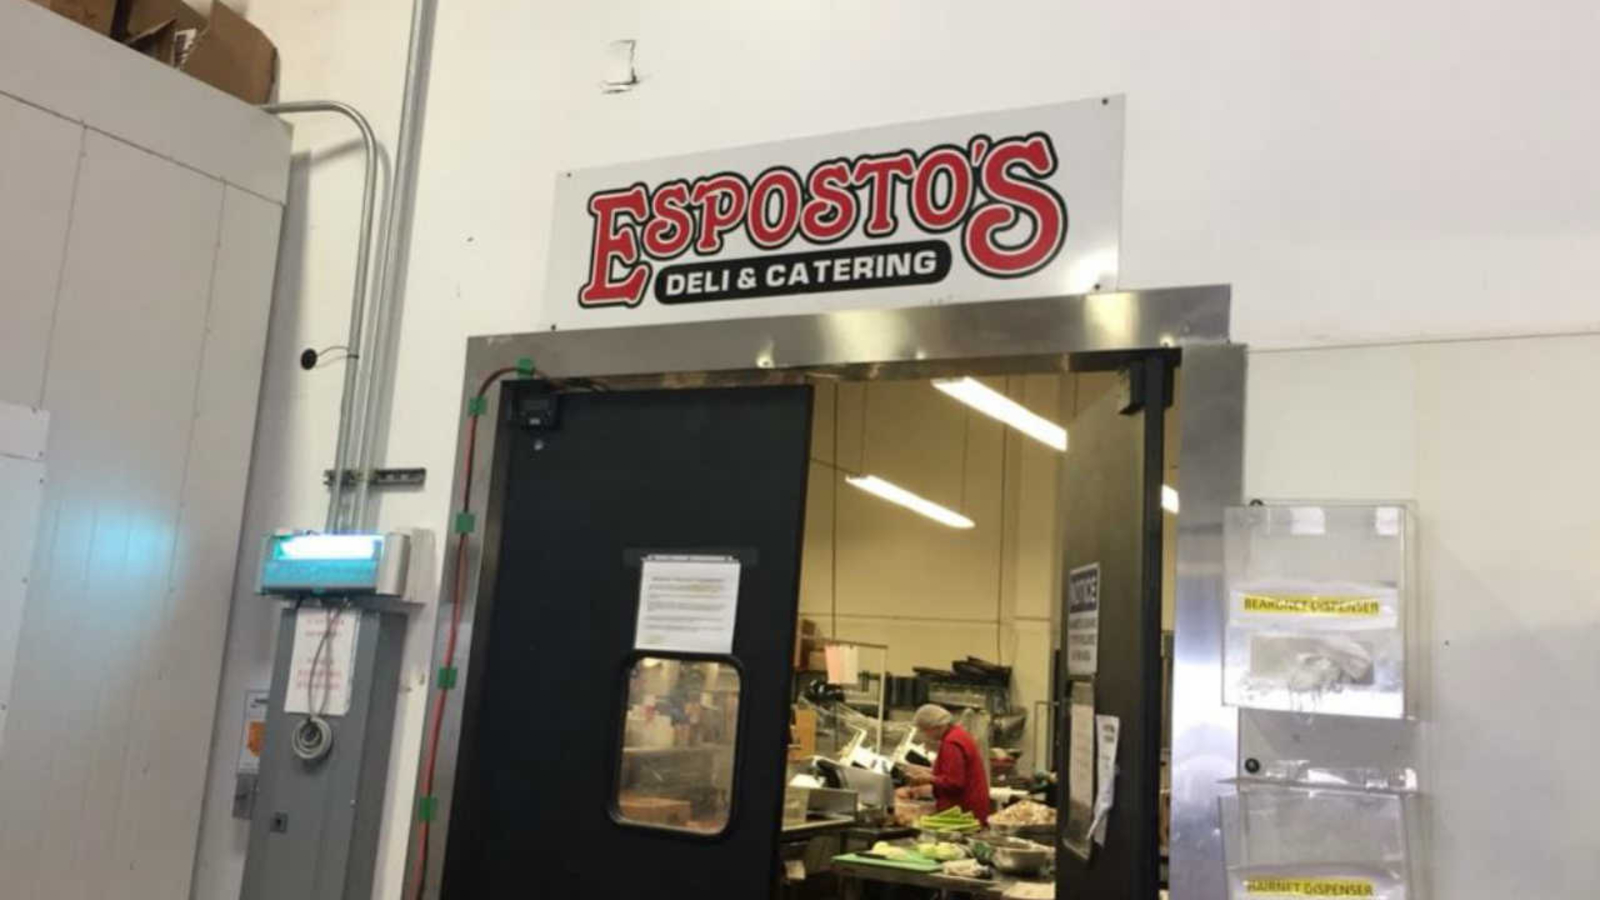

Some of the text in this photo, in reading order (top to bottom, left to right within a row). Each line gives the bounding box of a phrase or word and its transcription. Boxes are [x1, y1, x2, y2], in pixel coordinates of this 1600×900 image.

[579, 131, 1067, 307] ESPOSTO'S
[665, 250, 938, 296] DELI & CATERING
[1303, 881, 1374, 896] DISPENSER
